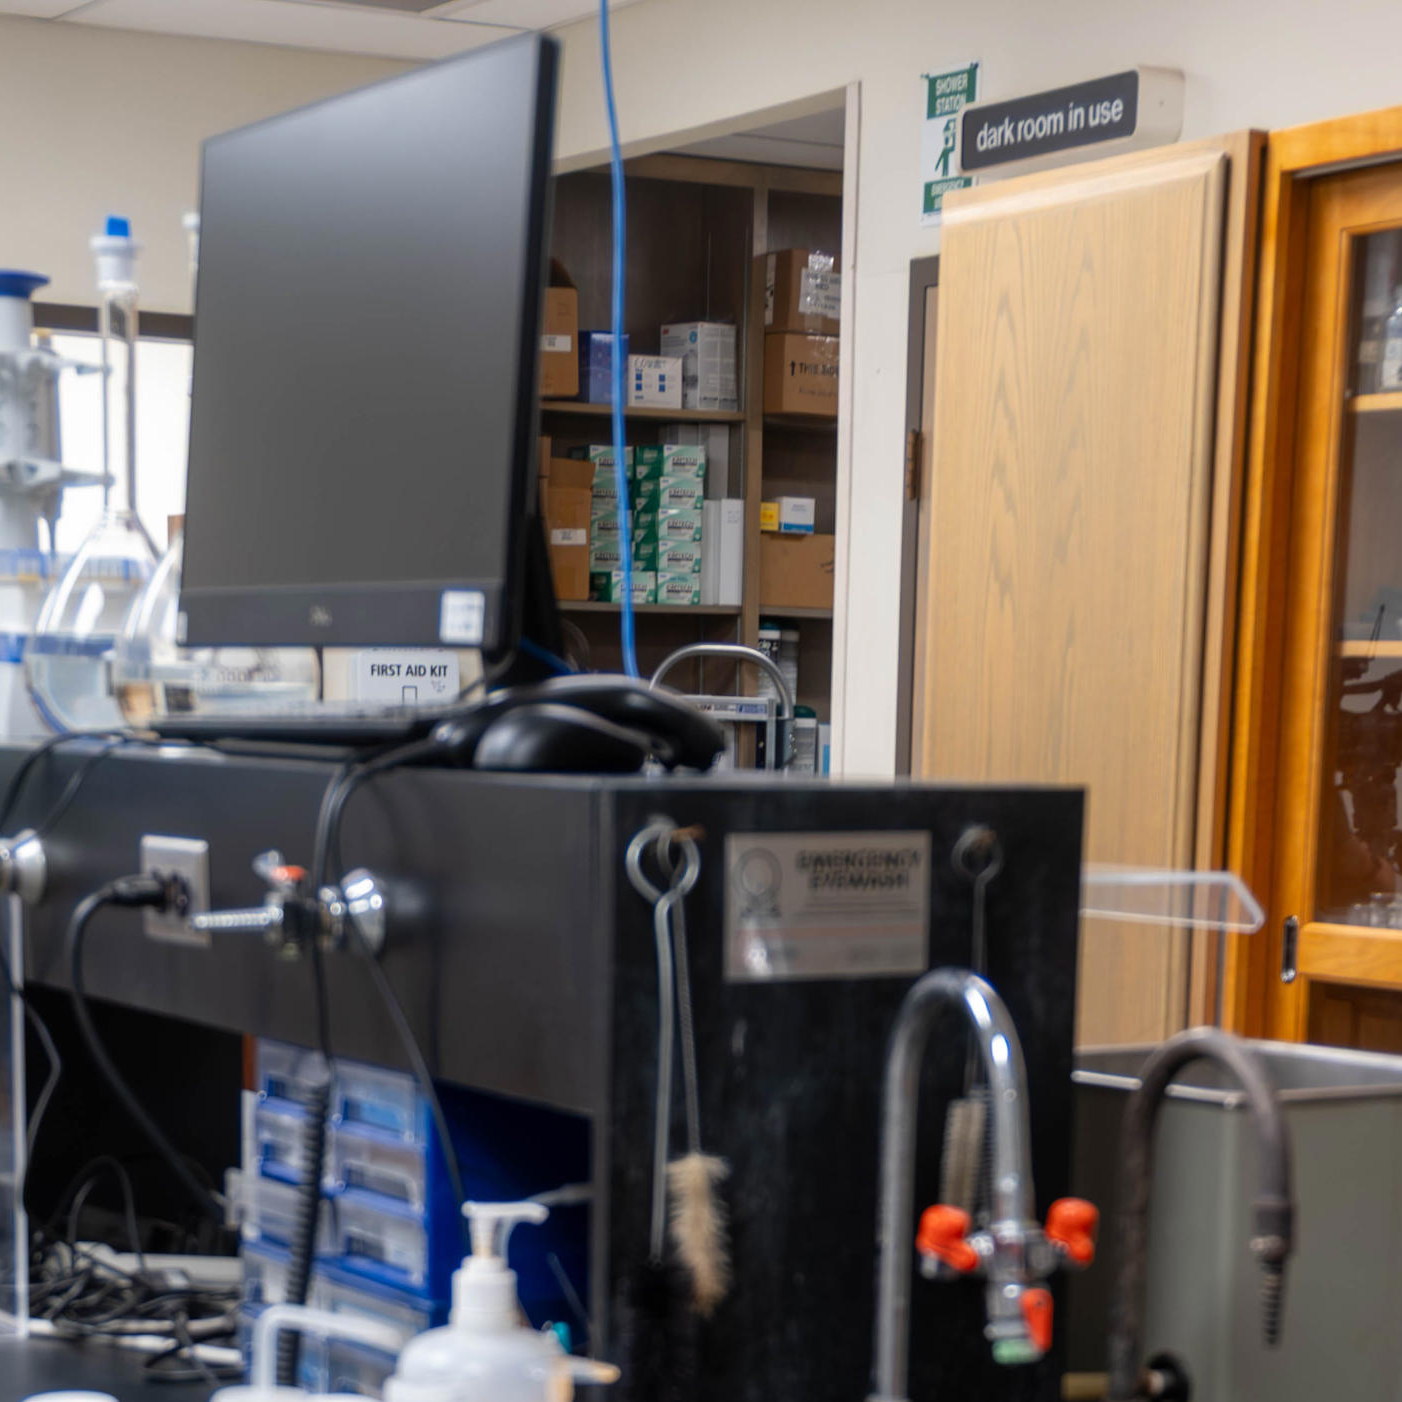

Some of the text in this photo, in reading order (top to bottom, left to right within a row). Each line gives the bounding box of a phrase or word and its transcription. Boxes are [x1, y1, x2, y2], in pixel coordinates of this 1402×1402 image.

[935, 72, 968, 97] SHOWER
[976, 97, 1124, 152] dark room in use
[370, 663, 448, 678] FIRST AID KIT
